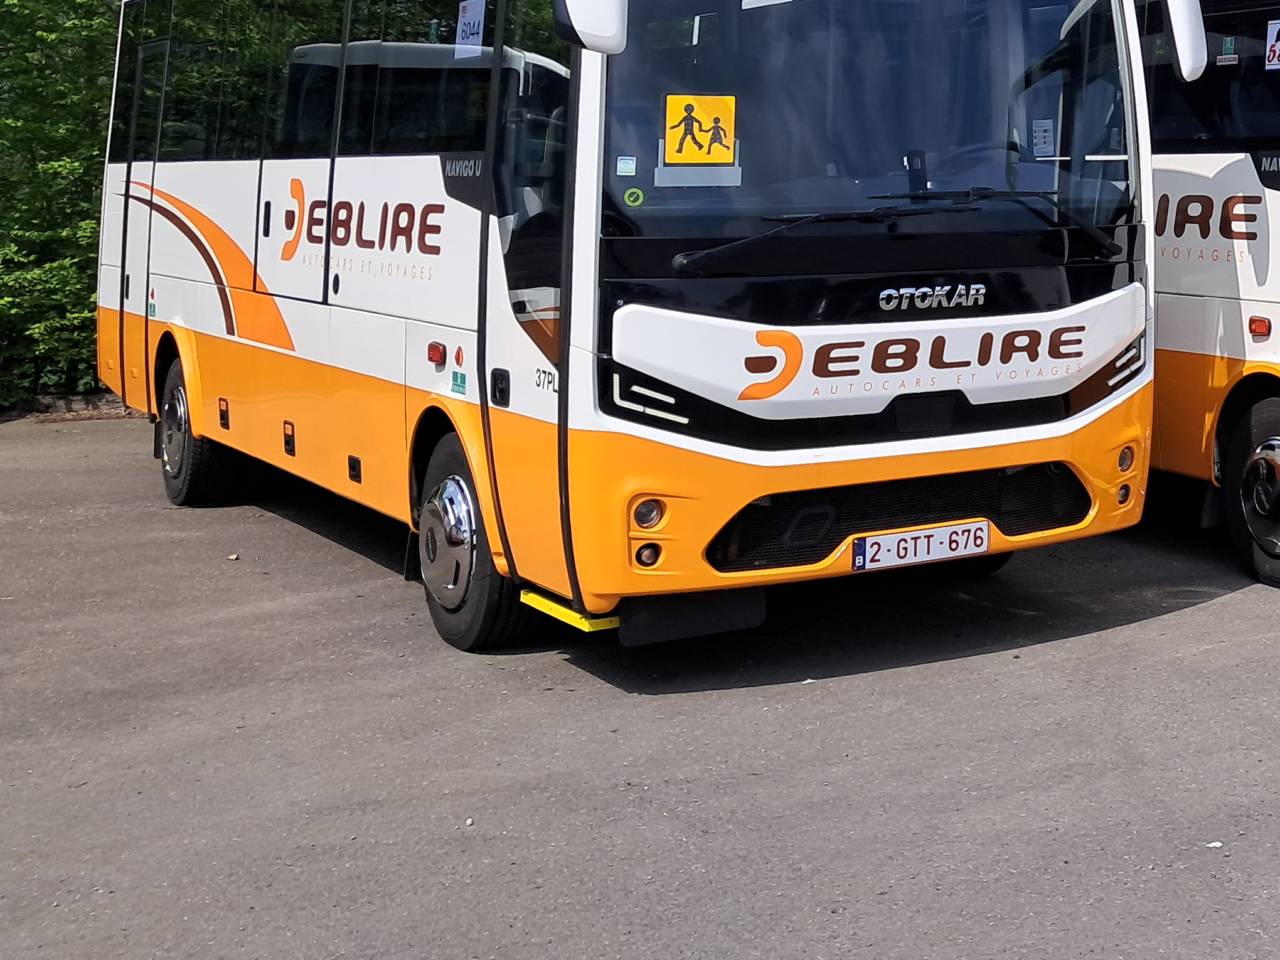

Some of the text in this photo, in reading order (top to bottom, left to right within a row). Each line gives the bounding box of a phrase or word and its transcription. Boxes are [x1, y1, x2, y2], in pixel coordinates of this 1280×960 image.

[461, 20, 481, 41] 6044
[445, 159, 482, 177] NAVIGO U
[1160, 246, 1245, 263] VOYAGES
[361, 260, 372, 273] ET
[380, 262, 433, 281] VOYAGES
[879, 284, 987, 311] OTOKAR
[737, 325, 1086, 401] DEBLIRE
[535, 368, 559, 393] 37PL
[812, 362, 1083, 396] AUTOCARS ET VOYAGES
[855, 527, 984, 566] B 2-GTT-676
